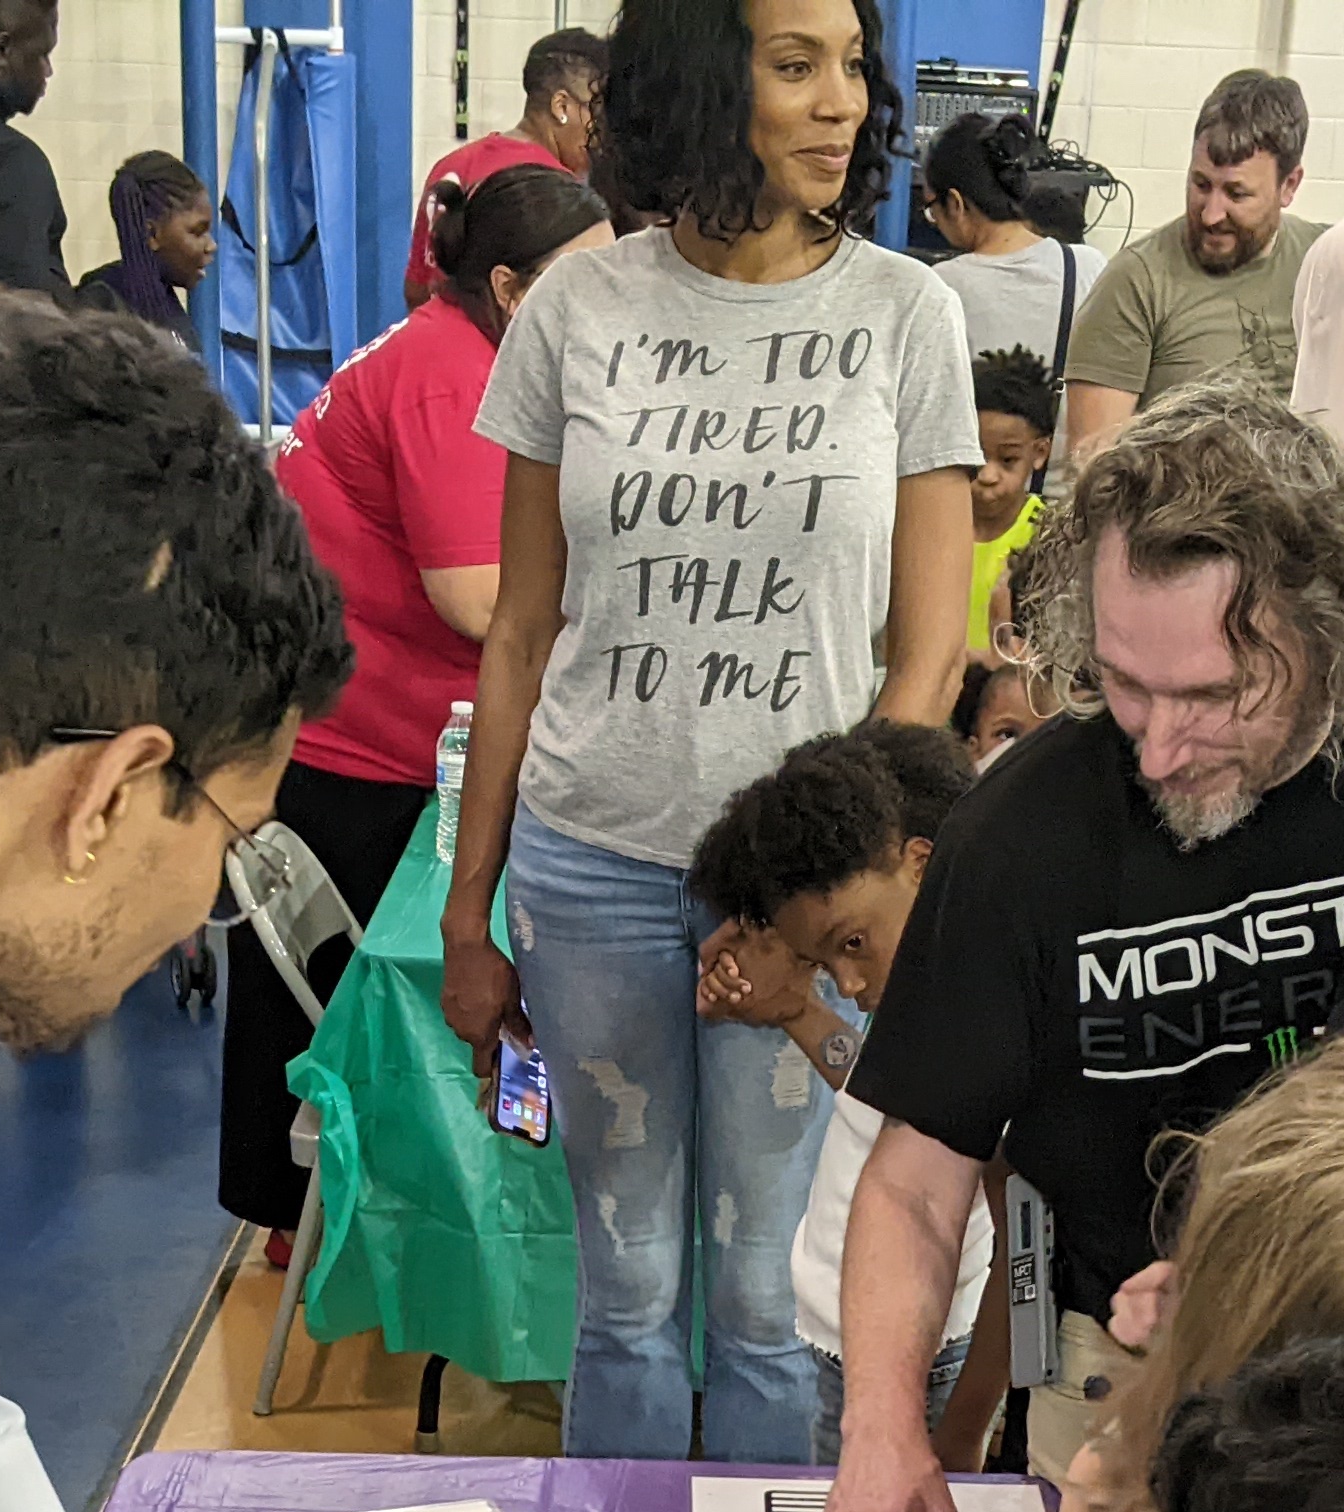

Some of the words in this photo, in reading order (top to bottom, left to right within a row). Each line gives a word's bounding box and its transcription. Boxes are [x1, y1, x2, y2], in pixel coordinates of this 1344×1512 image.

[606, 334, 729, 388] I'M
[746, 327, 873, 384] TOO
[617, 405, 839, 455] TIRED.
[609, 470, 861, 537] DON'T
[617, 554, 806, 625] TALK
[601, 642, 669, 703] TO
[697, 648, 812, 712] ME
[1079, 969, 1335, 1060] ENER
